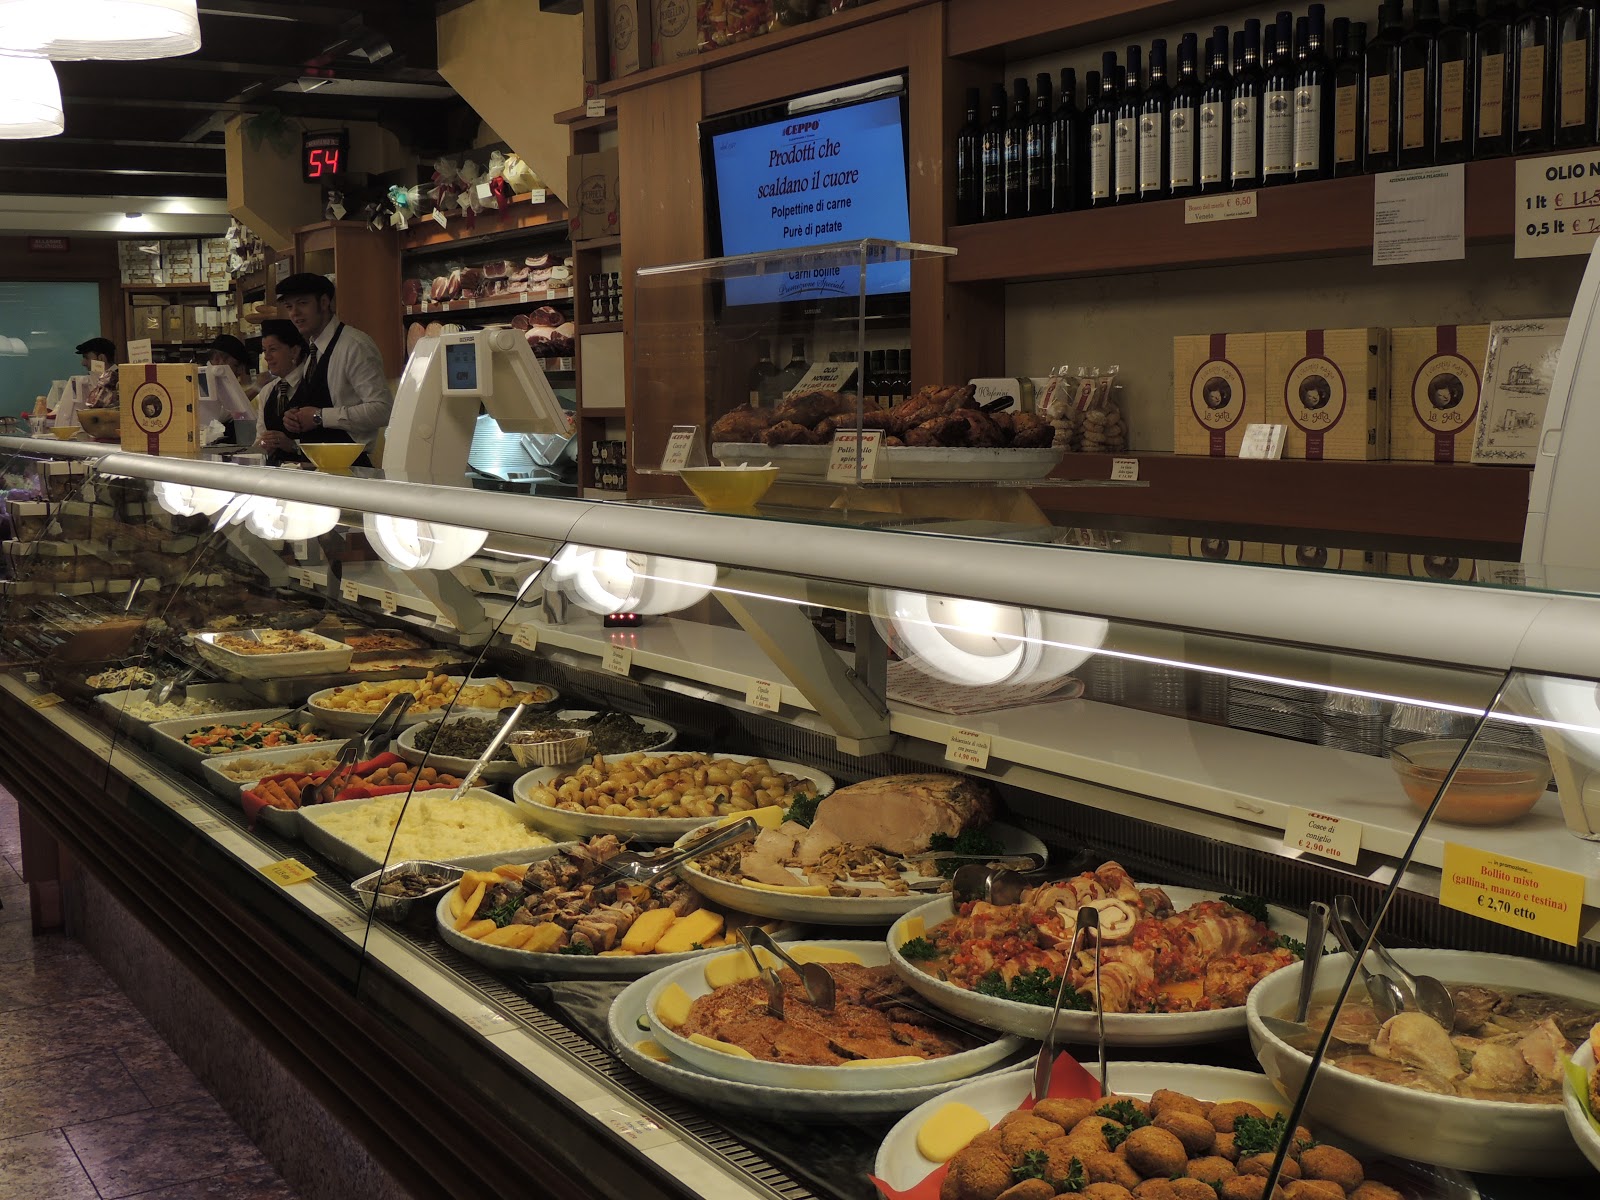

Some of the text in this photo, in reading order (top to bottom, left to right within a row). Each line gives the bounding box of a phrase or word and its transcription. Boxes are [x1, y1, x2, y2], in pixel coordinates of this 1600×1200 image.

[769, 138, 841, 168] Prodotti che
[309, 150, 338, 177] 54
[1546, 164, 1585, 181] OLIO
[758, 169, 859, 198] scaldano il cuore
[772, 198, 851, 219] Polpettine di carne
[1236, 197, 1251, 206] 6,50
[1526, 198, 1531, 209] 1
[1536, 195, 1547, 208] lt
[1555, 193, 1564, 207] €
[784, 220, 842, 238] Purè di patate
[1526, 222, 1549, 236] 0,5
[1554, 220, 1564, 233] lt
[1572, 219, 1580, 231] €
[1204, 411, 1232, 422] La gata
[1299, 410, 1331, 422] La gata
[1427, 411, 1463, 424] La gata
[1308, 821, 1335, 834] Cosce di
[1306, 832, 1332, 843] coniglio
[1306, 841, 1324, 852] 2,90
[1326, 847, 1341, 857] etto
[1481, 866, 1539, 889] Bollito misto
[1452, 873, 1488, 891] (gallina,
[1491, 886, 1521, 899] manzo
[1531, 895, 1568, 912] testina)
[1478, 894, 1536, 921] € 2,70 etto
